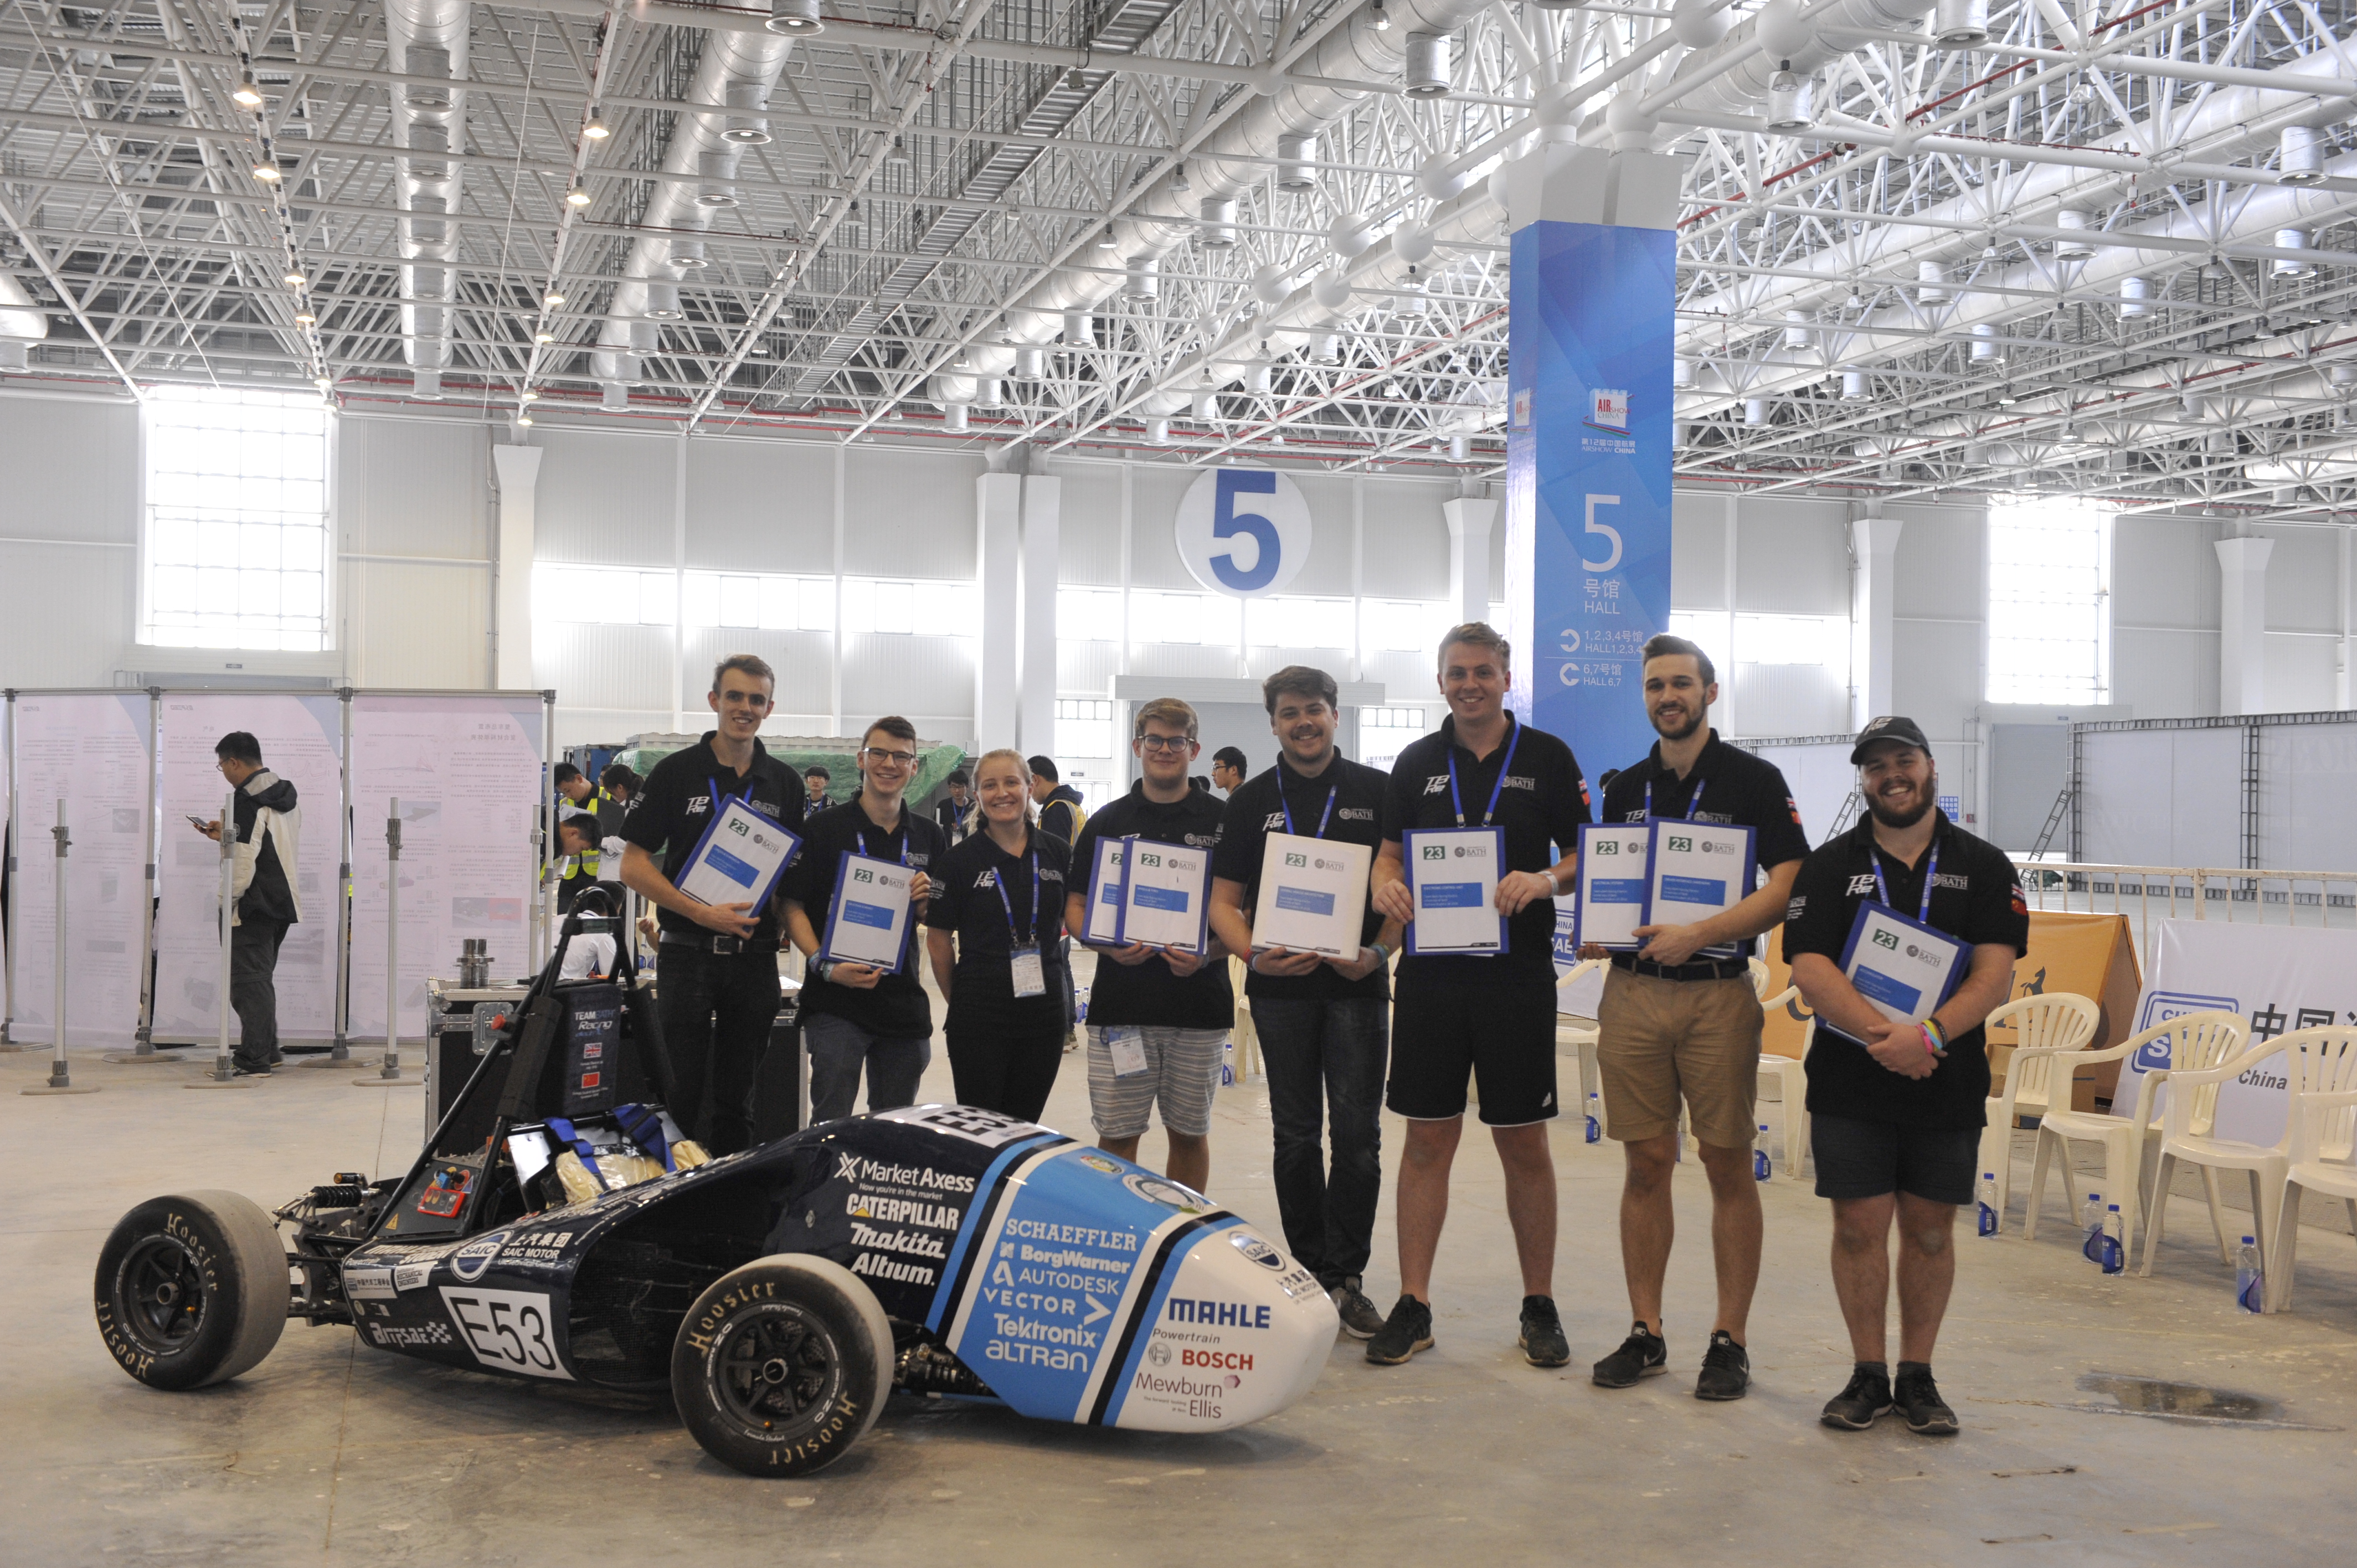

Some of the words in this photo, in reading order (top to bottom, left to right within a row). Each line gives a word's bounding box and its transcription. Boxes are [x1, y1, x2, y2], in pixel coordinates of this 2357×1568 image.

[1209, 468, 1281, 591] 5
[1582, 493, 1623, 572] 5
[1583, 579, 1620, 599] 号馆
[1584, 601, 1620, 615] HALL
[1583, 664, 1622, 676] 6,7号馆
[1583, 677, 1607, 686] HALL
[1608, 678, 1622, 687] 6,7
[1427, 775, 1450, 786] TB
[1511, 780, 1535, 790] BATH
[687, 796, 710, 805] TB
[761, 804, 780, 816] BATH
[1352, 811, 1373, 819] BATH
[1707, 815, 1732, 824] BATH
[730, 821, 747, 835] 23
[761, 839, 779, 853] BATH
[1599, 842, 1616, 854] 23
[1671, 838, 1689, 850] 23
[1713, 844, 1735, 853] BATH
[1113, 854, 1121, 865] 2
[1288, 854, 1304, 866] 23
[1426, 847, 1443, 859] 23
[1143, 855, 1158, 866] 23
[1179, 862, 1196, 870] BATH
[1325, 862, 1344, 871] BATH
[857, 869, 871, 882] 23
[1849, 874, 1876, 885] TB
[1941, 876, 1968, 888] BATH
[889, 878, 905, 888] BATH
[1556, 920, 1573, 930] HINA
[1551, 937, 1573, 955] AE
[1875, 932, 1895, 948] 23
[1918, 951, 1941, 966] BATH
[2238, 1069, 2287, 1090] China
[859, 1182, 874, 1192] Now
[876, 1185, 897, 1194] you're
[897, 1186, 904, 1195] in
[905, 1188, 917, 1196] the
[918, 1191, 943, 1200] market
[846, 1193, 959, 1231] CATERPILLAR
[508, 1232, 574, 1248] 上汽集团
[1006, 1218, 1137, 1252] SCHAEFFLER
[164, 1213, 218, 1291] Hoosier
[461, 1244, 497, 1256] SAIC
[502, 1247, 526, 1257] SAIC
[524, 1248, 560, 1258] MOTOR
[1246, 1245, 1271, 1258] SAIC
[1020, 1244, 1130, 1274] BorgWarner
[397, 1270, 424, 1279] MECHANICAL
[1018, 1267, 1119, 1296] AUTODESK
[984, 1287, 1076, 1316] VECTOR
[686, 1281, 775, 1358] Hoosier
[1169, 1297, 1270, 1329] MAHLE
[449, 1296, 556, 1371] E53
[994, 1313, 1097, 1348] Tektronix
[1152, 1328, 1221, 1344] Powertrain
[1182, 1349, 1253, 1371] BOSCH
[1136, 1372, 1222, 1399] Mewburn
[1190, 1400, 1222, 1419] Ellis
[770, 1391, 857, 1464] Hoosier
